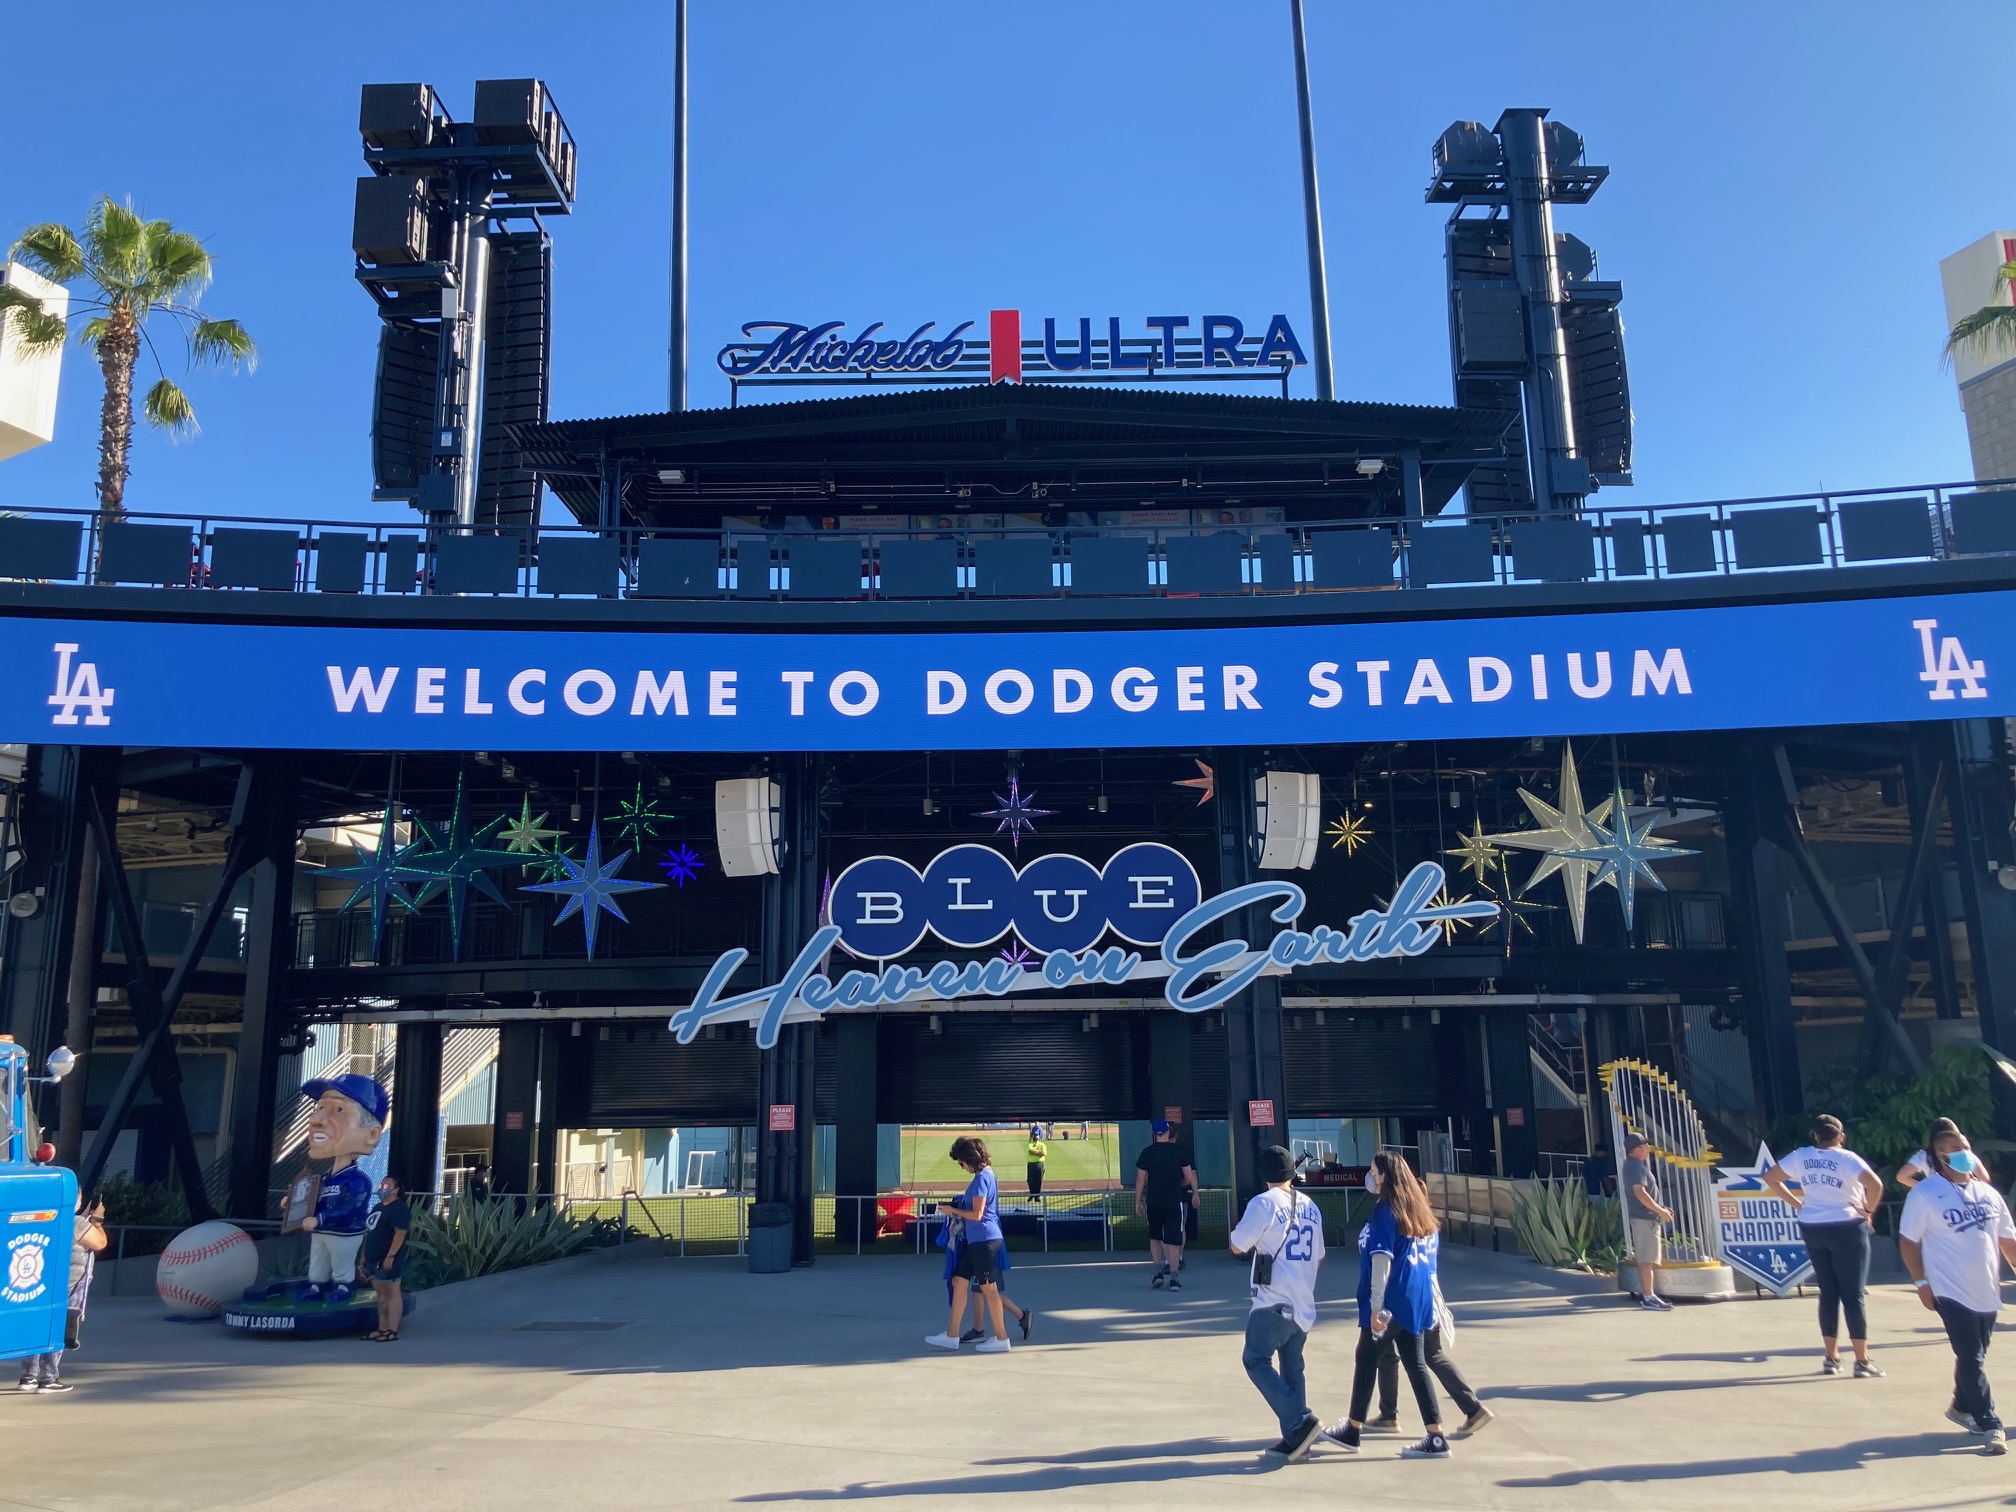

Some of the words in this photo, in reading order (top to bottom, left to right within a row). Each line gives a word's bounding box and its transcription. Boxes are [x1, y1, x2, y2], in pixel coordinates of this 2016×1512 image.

[717, 320, 975, 378] Michelob
[1043, 314, 1309, 372] ULTRA
[1912, 618, 1988, 701] LA
[49, 642, 115, 727] LA
[326, 665, 740, 717] WELCOME
[781, 671, 881, 717] TO
[927, 664, 1264, 715] DODGER
[1308, 647, 1694, 710] STADIUM
[856, 876, 1176, 925] BLUE
[668, 924, 1023, 1049] Heaven
[1042, 946, 1143, 989] on
[1161, 861, 1501, 1013] Earth
[1323, 1173, 1358, 1183] MEDICAL
[1803, 1158, 1839, 1172] DODGERS
[1800, 1173, 1819, 1187] BLUE
[1820, 1173, 1844, 1189] CREW
[1722, 1206, 1737, 1215] 20
[7, 1232, 51, 1251] DODGER
[1285, 1224, 1314, 1262] 23
[1768, 1248, 1788, 1274] LA
[1, 1282, 47, 1304] STADIUM
[225, 1312, 248, 1327] TOMMY
[250, 1316, 296, 1329] LASORDA
